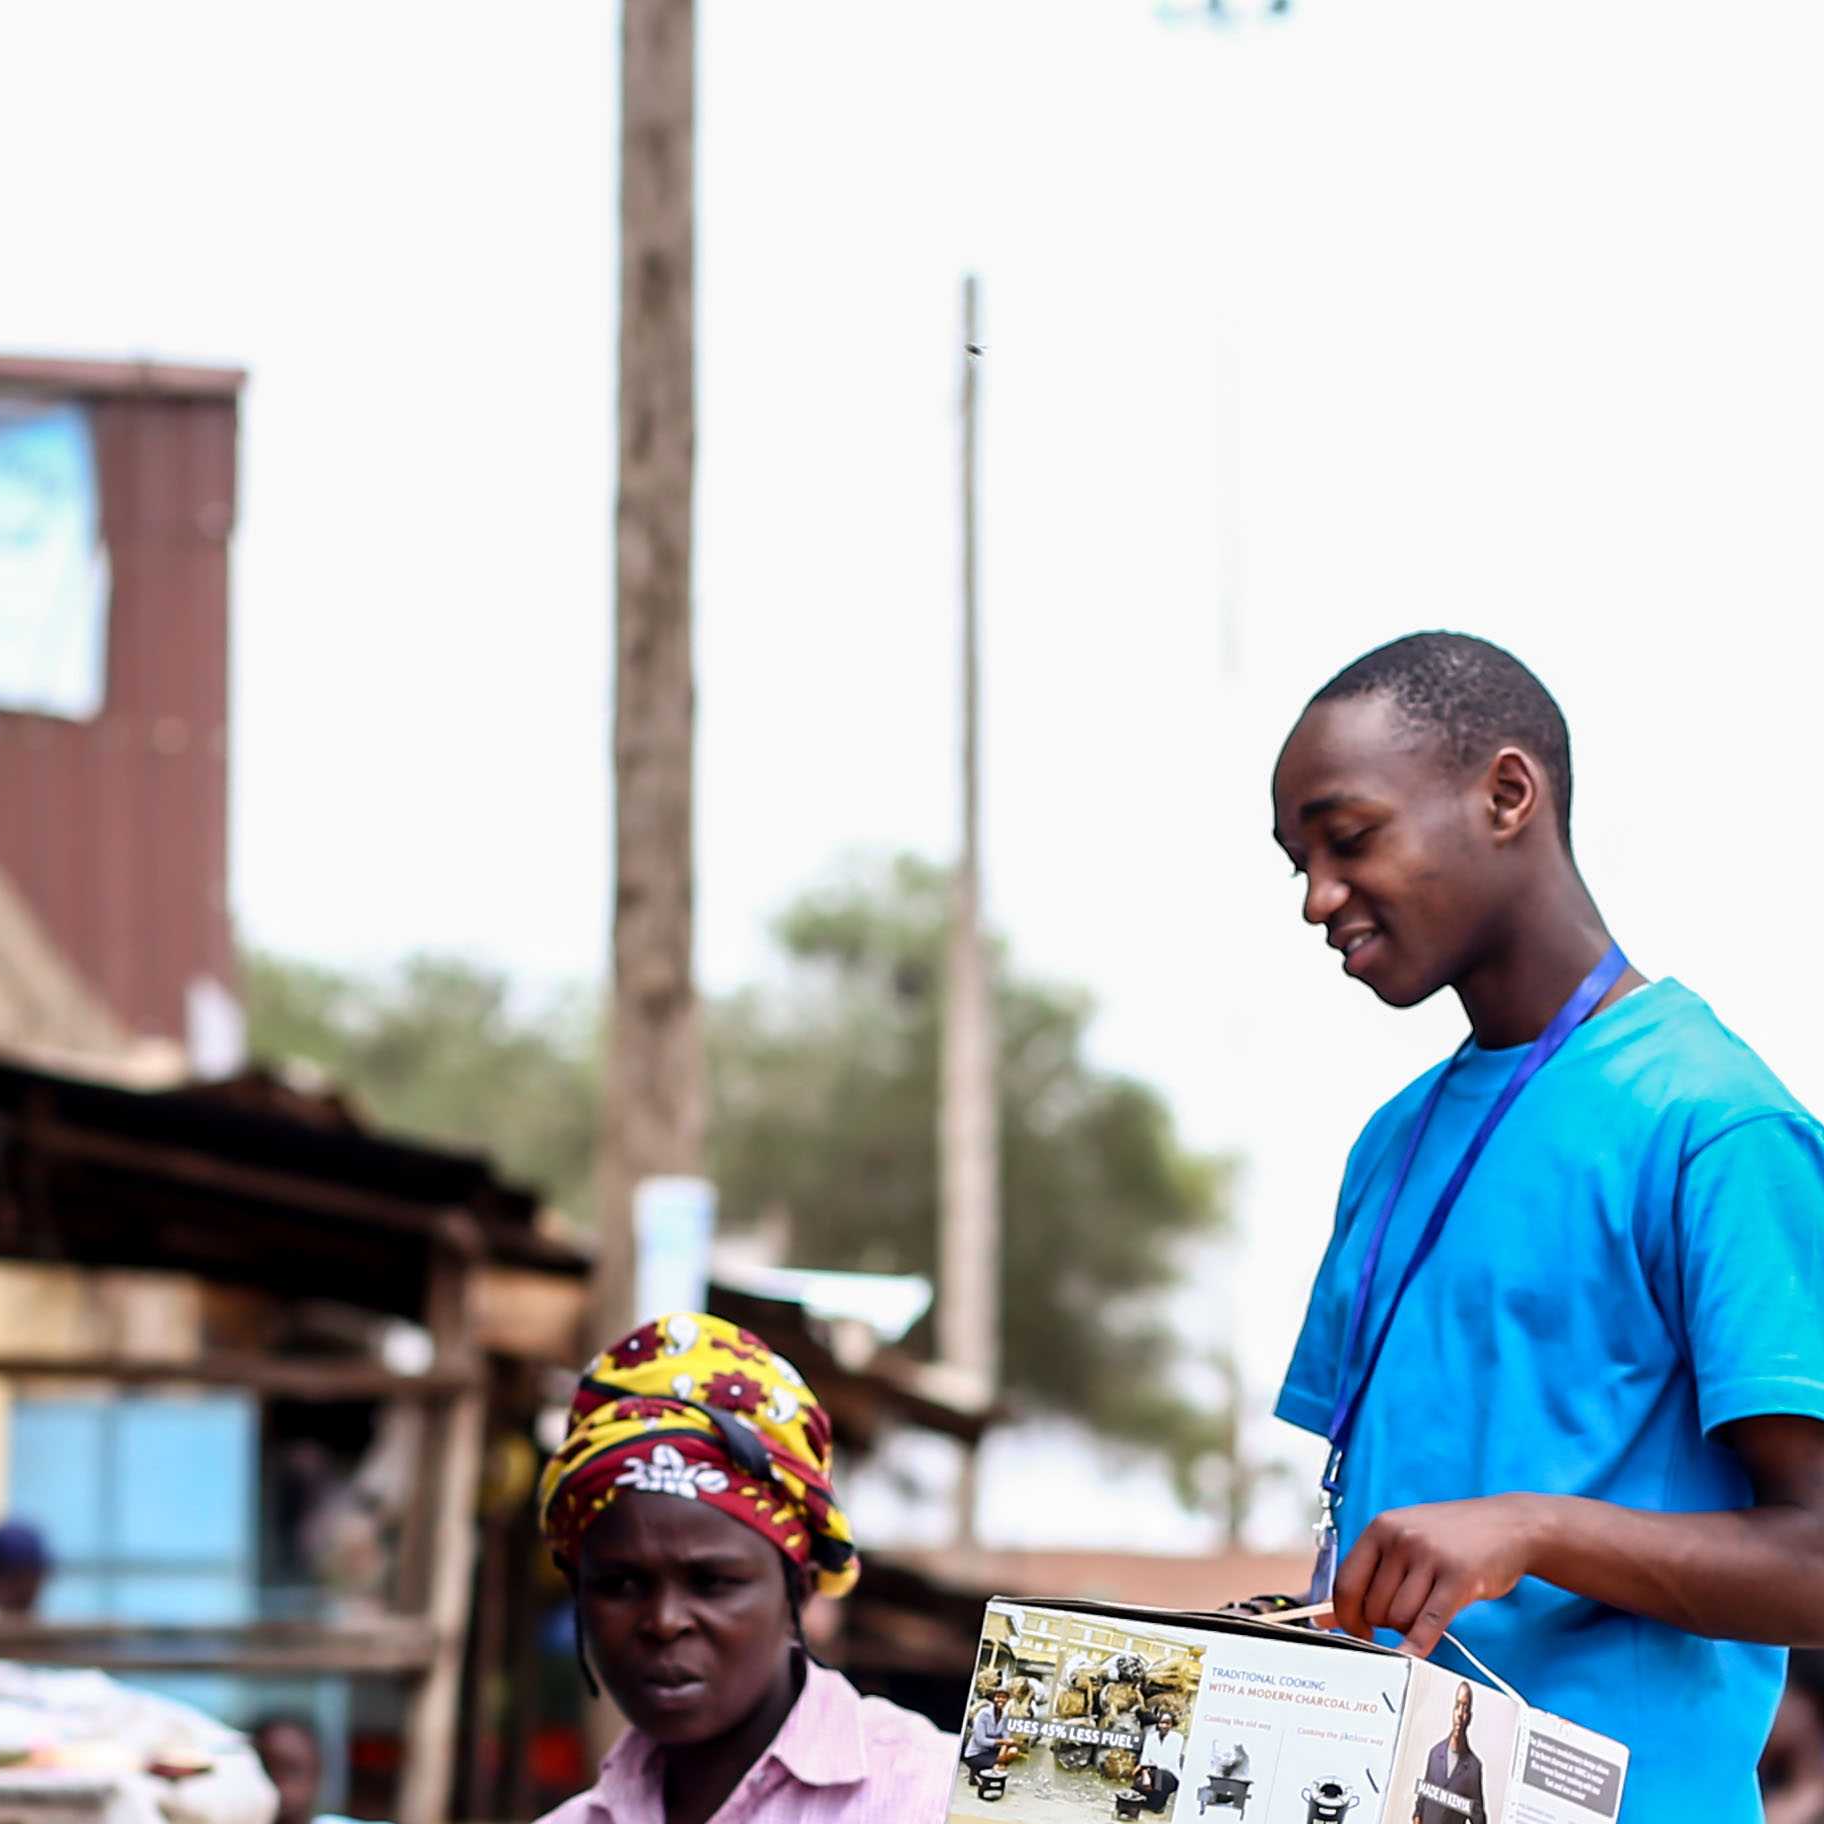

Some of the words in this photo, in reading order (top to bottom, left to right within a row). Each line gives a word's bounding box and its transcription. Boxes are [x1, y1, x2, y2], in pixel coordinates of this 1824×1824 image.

[1212, 1666, 1276, 1686] TRADITIONAL
[1278, 1675, 1327, 1692] COOKING
[1208, 1683, 1236, 1695] WITH
[1237, 1686, 1245, 1696] A
[1247, 1687, 1293, 1702] MODERN
[1295, 1693, 1352, 1712] CHARCOAL
[1352, 1701, 1378, 1714] JIKO
[1007, 1718, 1038, 1735] USES
[1040, 1722, 1067, 1739] 45%
[1069, 1727, 1100, 1744] LESS
[1417, 1780, 1440, 1801] MADE
[1448, 1791, 1472, 1814] KENYA
